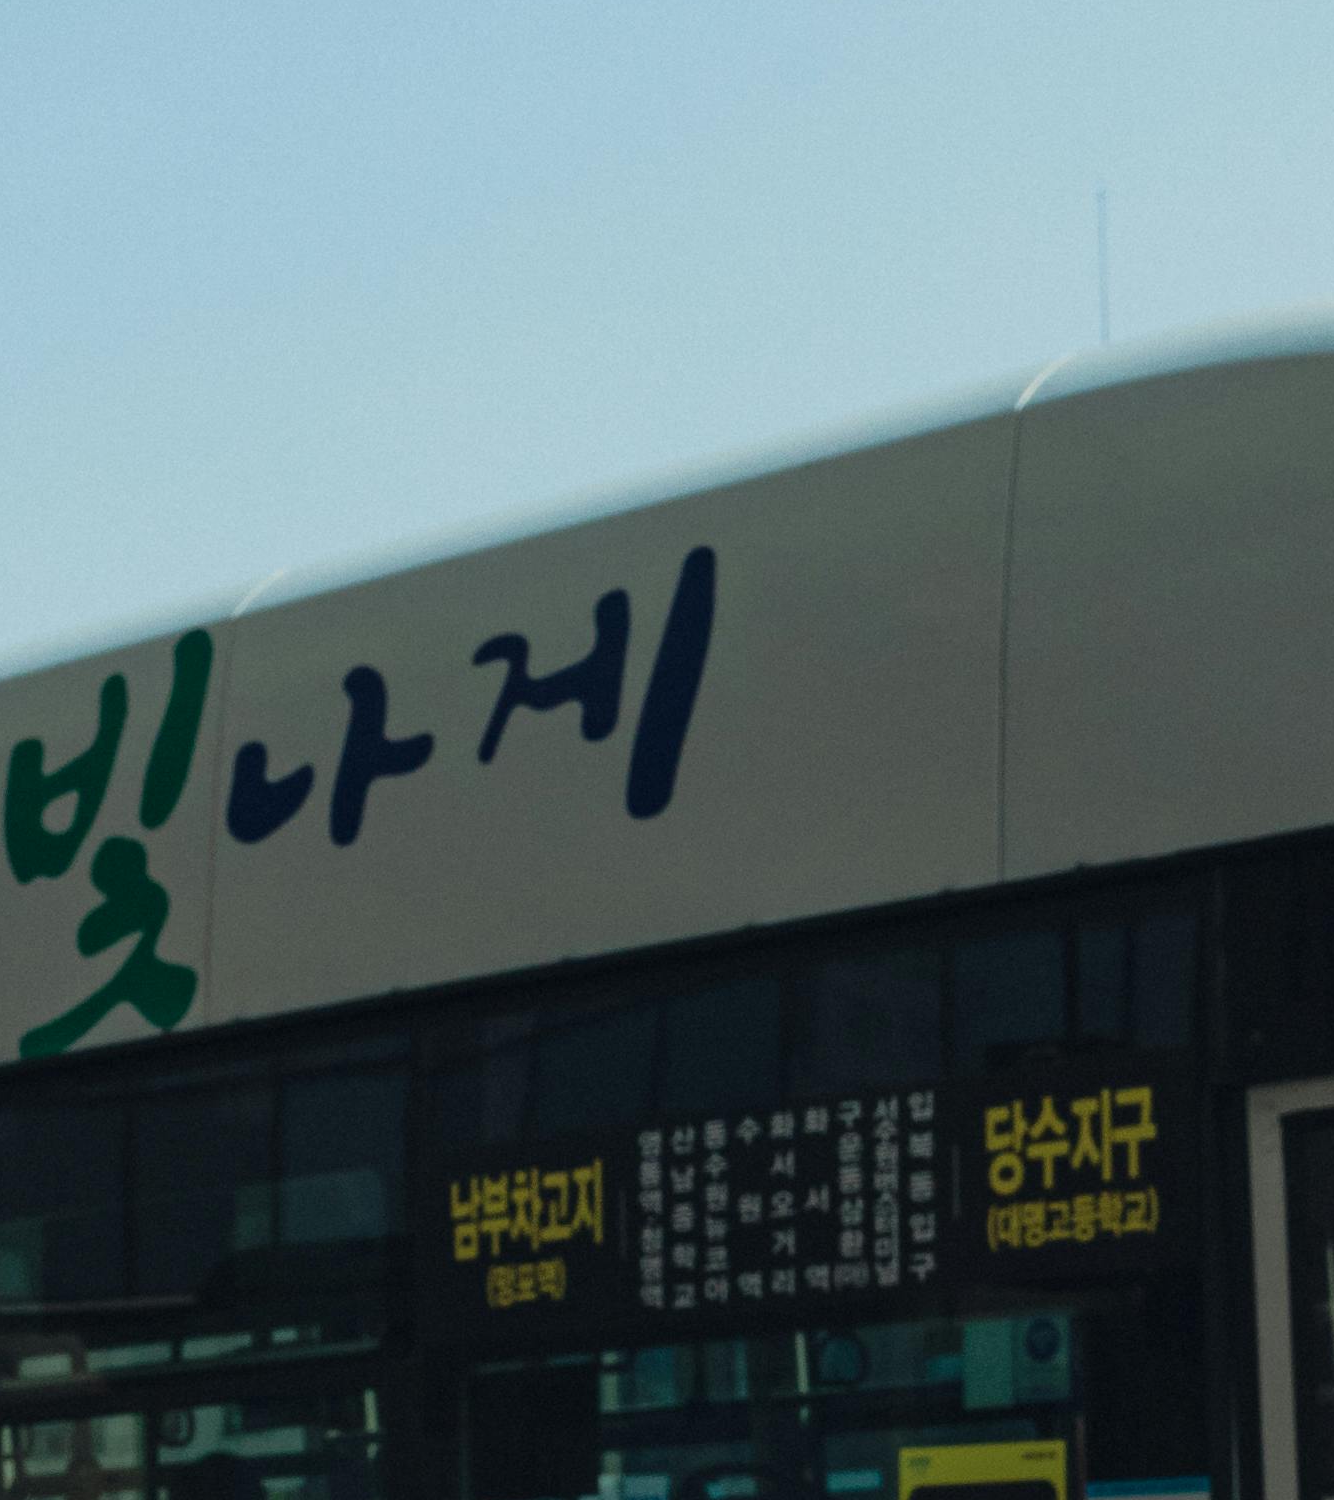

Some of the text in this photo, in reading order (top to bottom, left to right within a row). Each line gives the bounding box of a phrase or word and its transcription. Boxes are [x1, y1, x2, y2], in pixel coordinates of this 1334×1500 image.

[5, 544, 716, 1059] 빛나게
[449, 1157, 604, 1262] 남부차고지
[770, 1110, 796, 1296] 화서오거리
[873, 1094, 900, 1287] 서수원버스터미널
[908, 1090, 936, 1282] 입북동입구
[984, 1085, 1158, 1197] 당수지구
